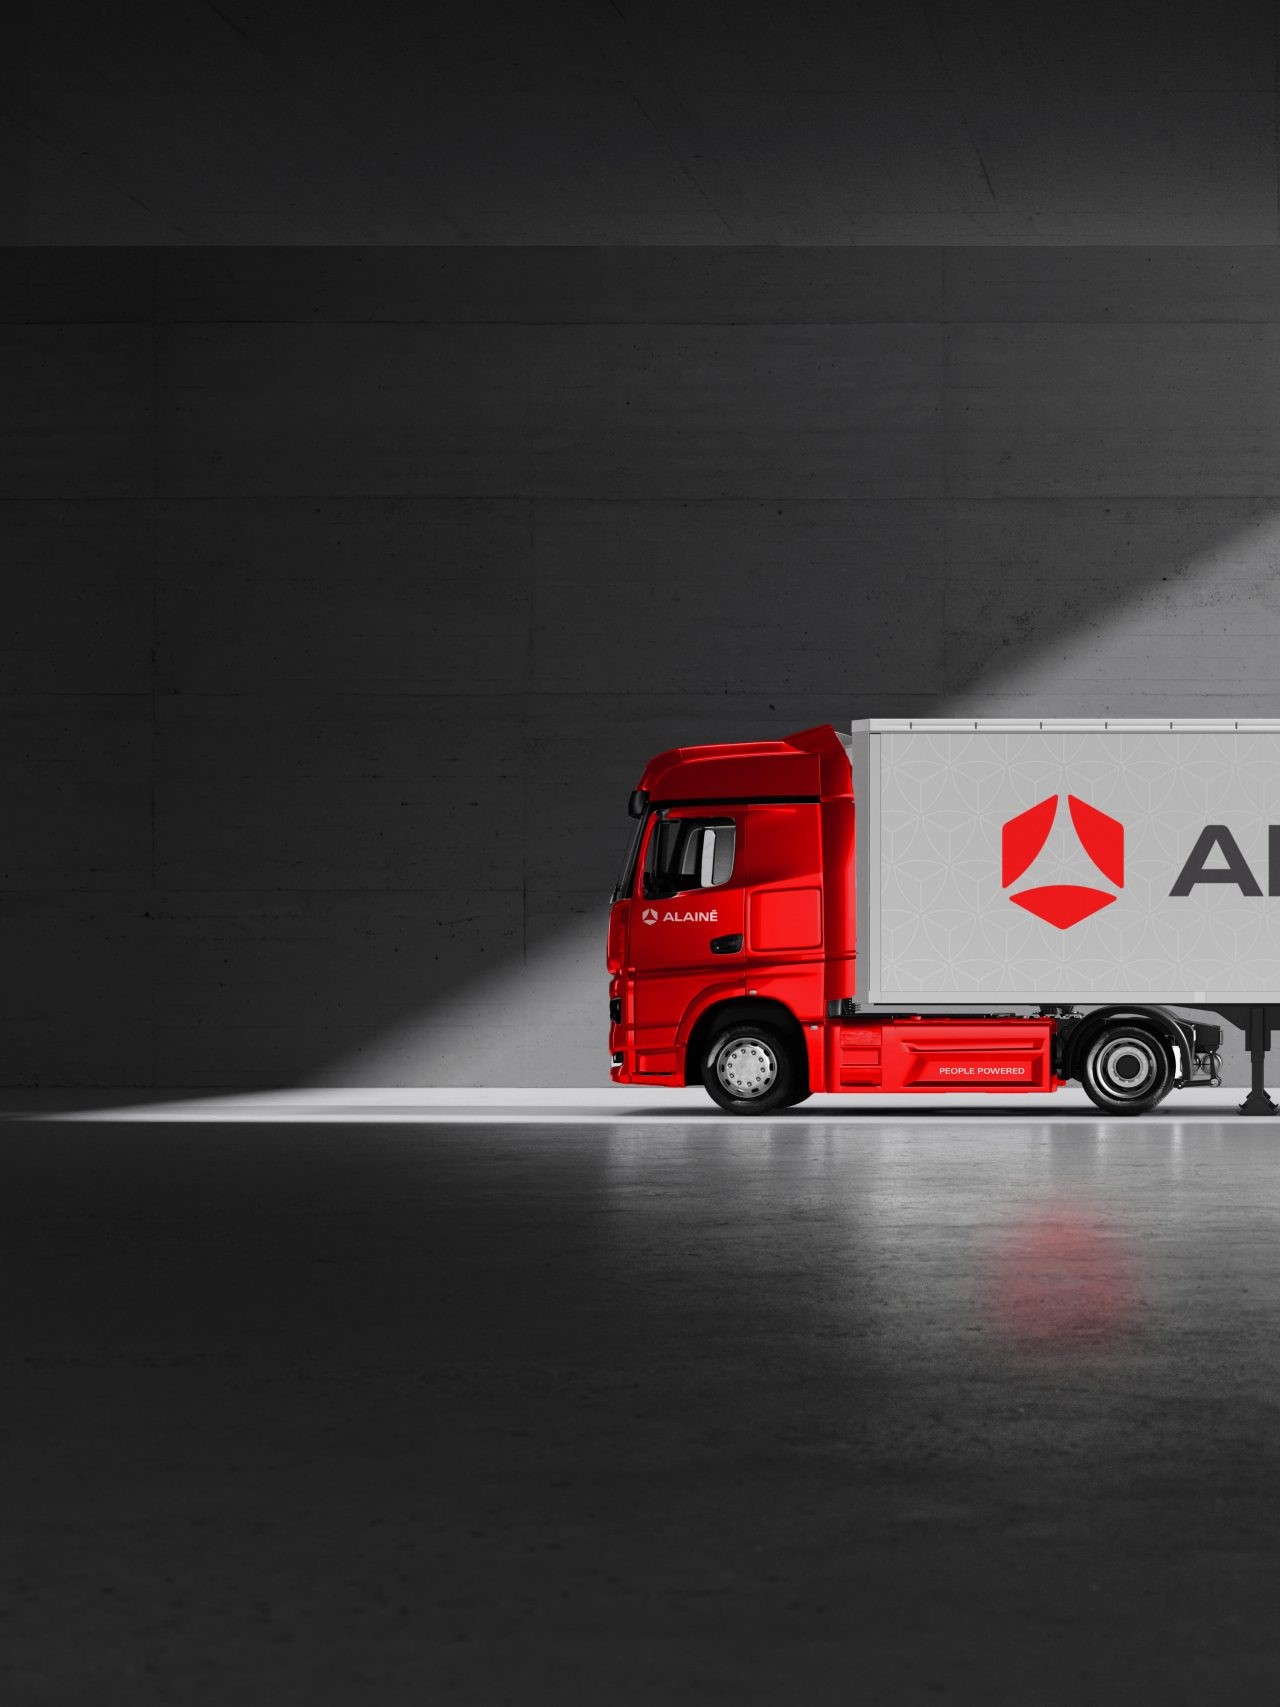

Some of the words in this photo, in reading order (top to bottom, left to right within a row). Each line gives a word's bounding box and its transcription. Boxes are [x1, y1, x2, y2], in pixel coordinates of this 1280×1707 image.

[663, 909, 718, 922] ALAINÉ
[939, 1067, 975, 1075] PEOPLE
[977, 1067, 1025, 1075] POWERED
